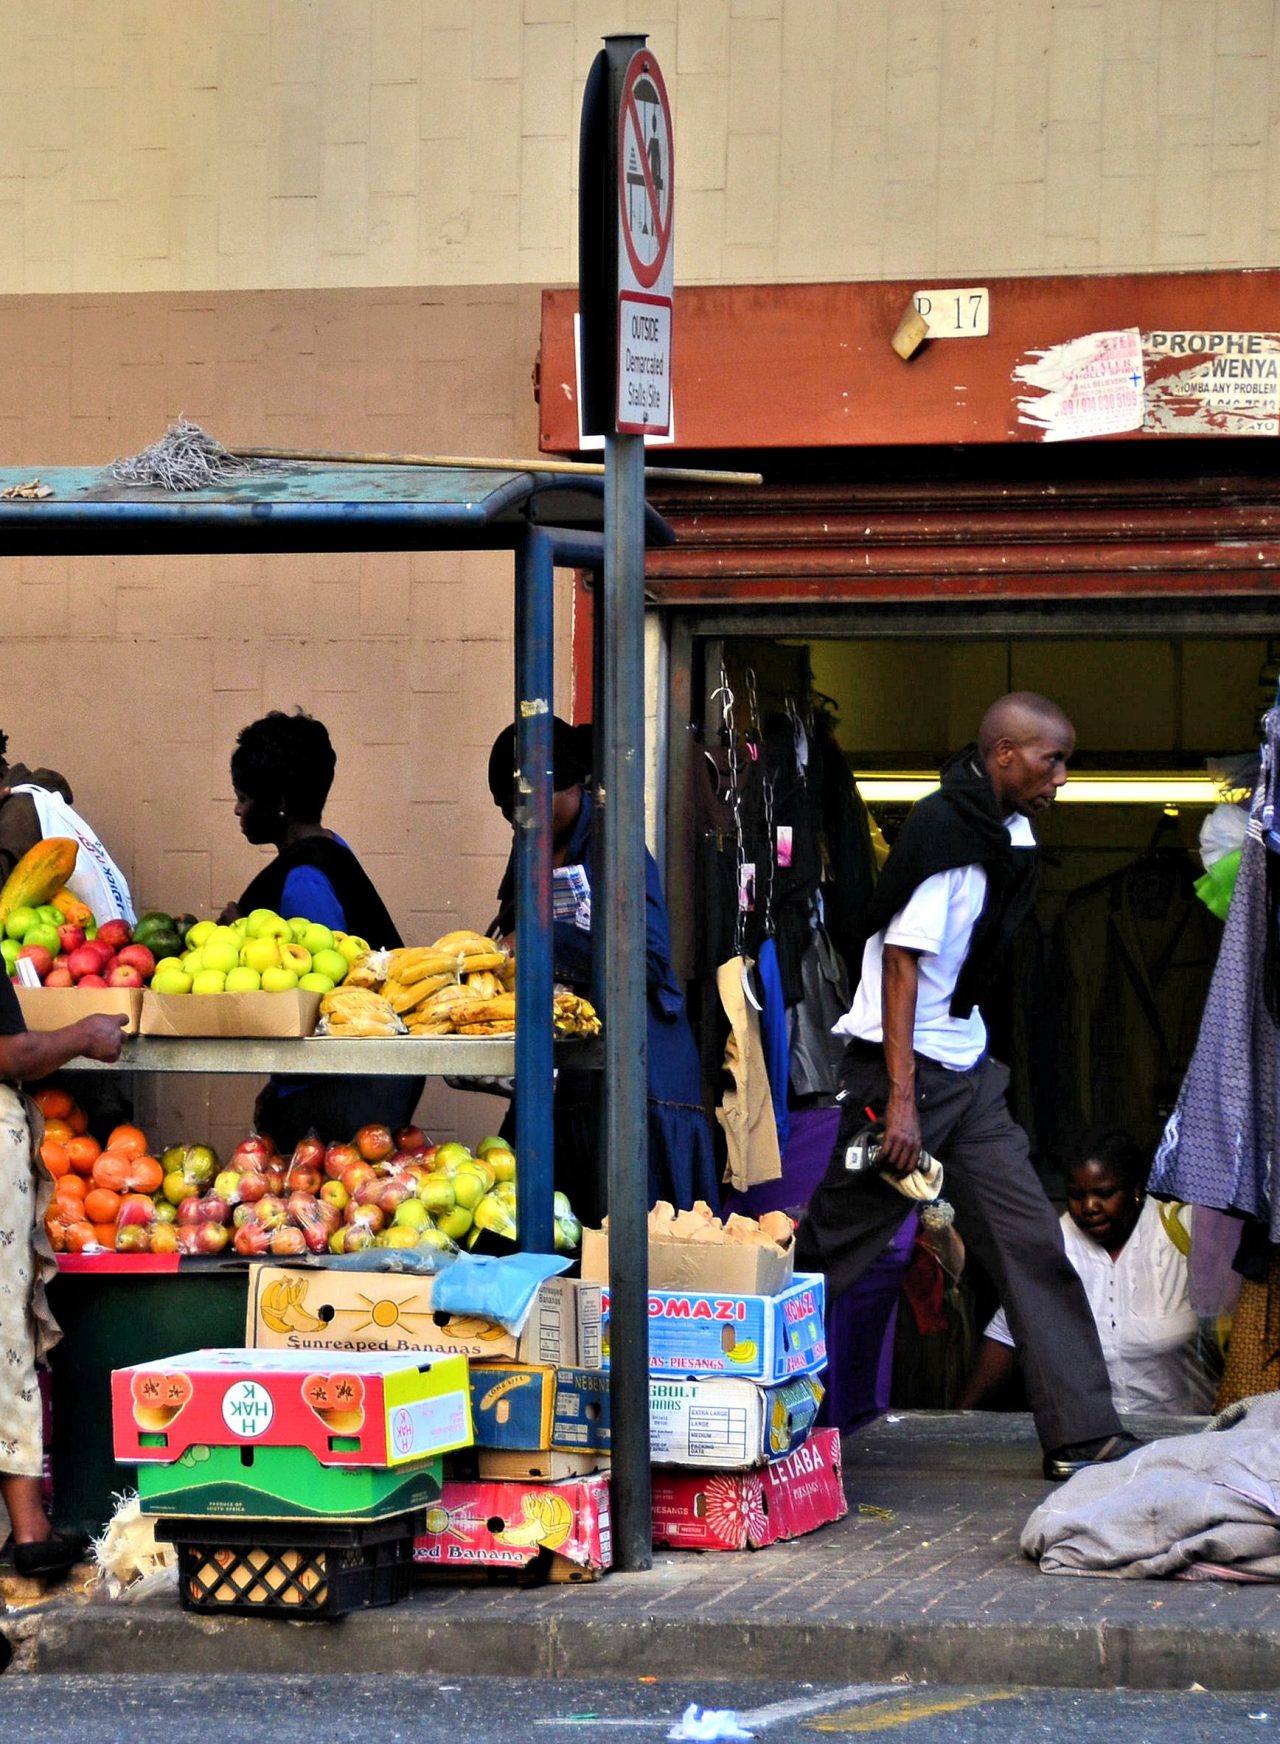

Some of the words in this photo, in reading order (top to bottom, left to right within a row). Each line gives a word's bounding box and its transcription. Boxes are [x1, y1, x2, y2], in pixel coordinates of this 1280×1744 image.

[916, 297, 932, 316] D
[954, 294, 983, 330] 17
[631, 314, 659, 342] OUTSIDE
[625, 347, 664, 376] Demarcated
[1212, 384, 1231, 394] ANY
[1234, 383, 1277, 394] PROBLEM
[648, 1298, 747, 1321] OMAZI
[287, 1335, 390, 1352] Sunreaped
[396, 1339, 481, 1355] Bananas
[669, 1357, 725, 1370] PIESANGS
[242, 1384, 256, 1399] K
[231, 1401, 268, 1417] HAK
[242, 1418, 256, 1434] H
[769, 1444, 825, 1486] LETABA
